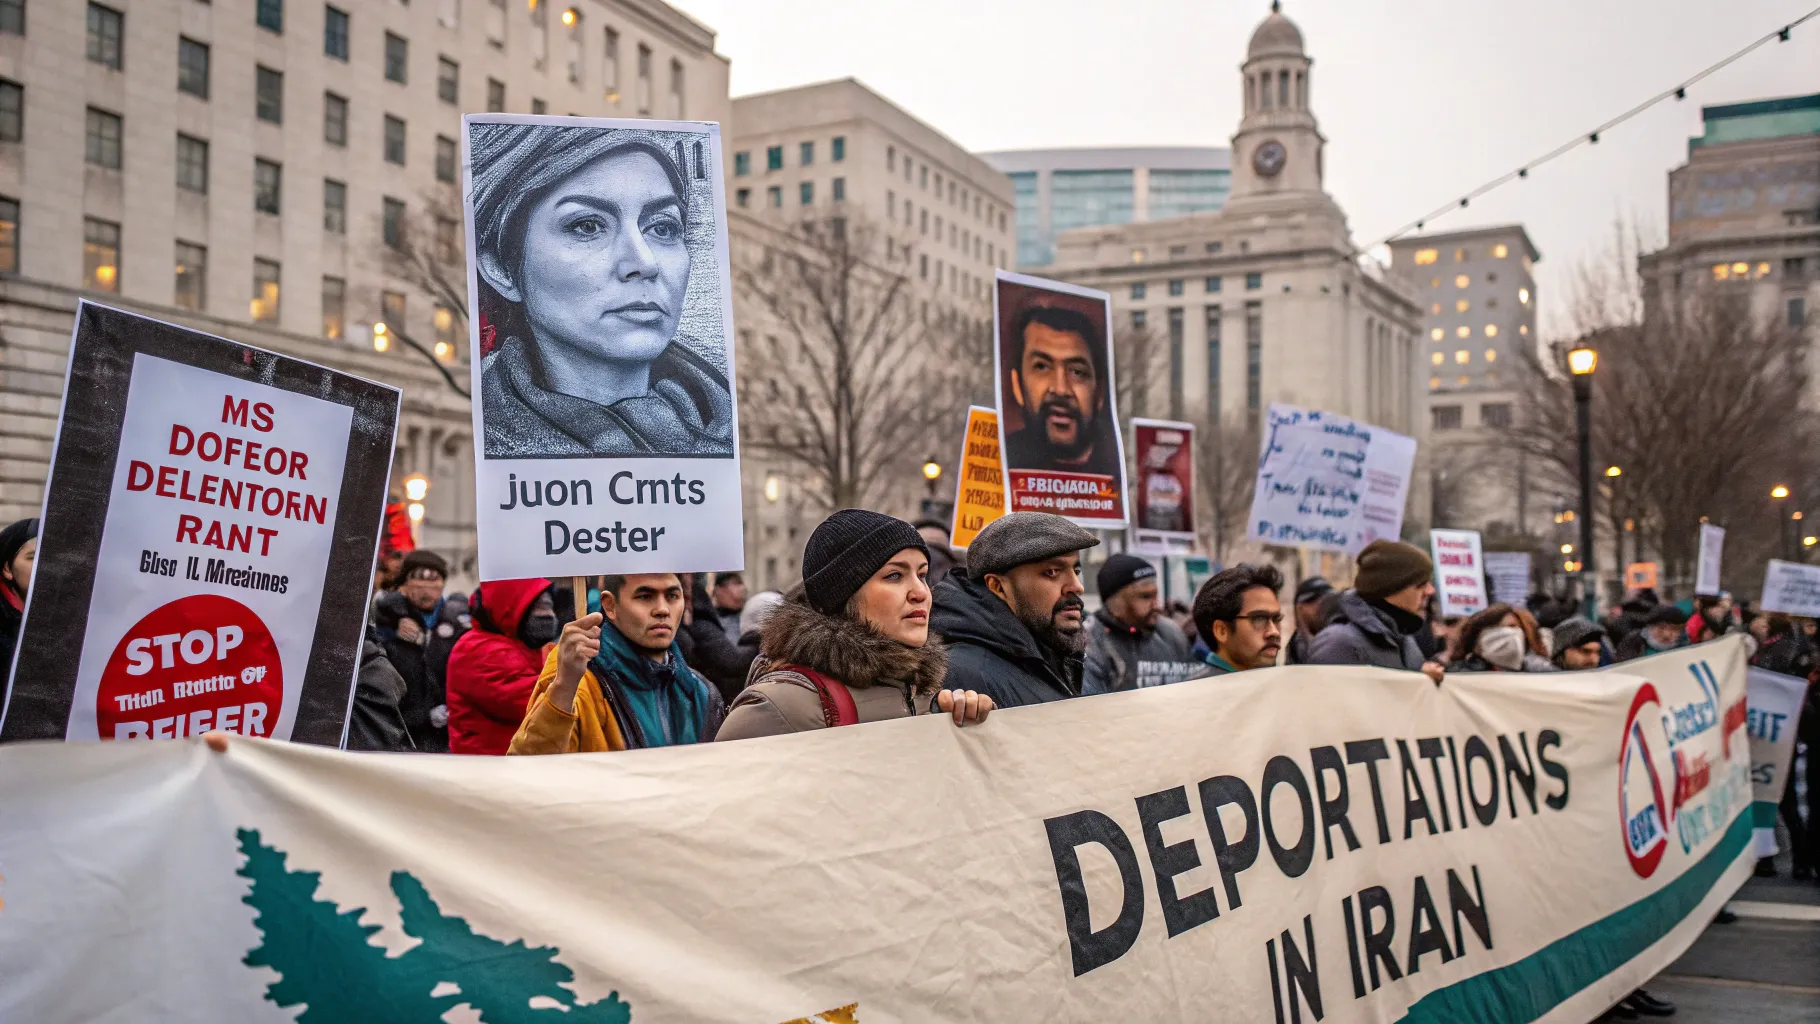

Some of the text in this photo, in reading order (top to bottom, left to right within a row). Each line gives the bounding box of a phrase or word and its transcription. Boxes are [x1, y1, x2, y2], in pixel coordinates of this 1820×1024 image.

[221, 394, 275, 432] MS
[168, 423, 309, 480] DOFEOR
[176, 513, 278, 556] RANT
[544, 520, 665, 555] Dester
[125, 625, 244, 676] STOP
[1042, 729, 1570, 978] DEPORTATIONS
[1265, 864, 1494, 1024] IN IRAN
